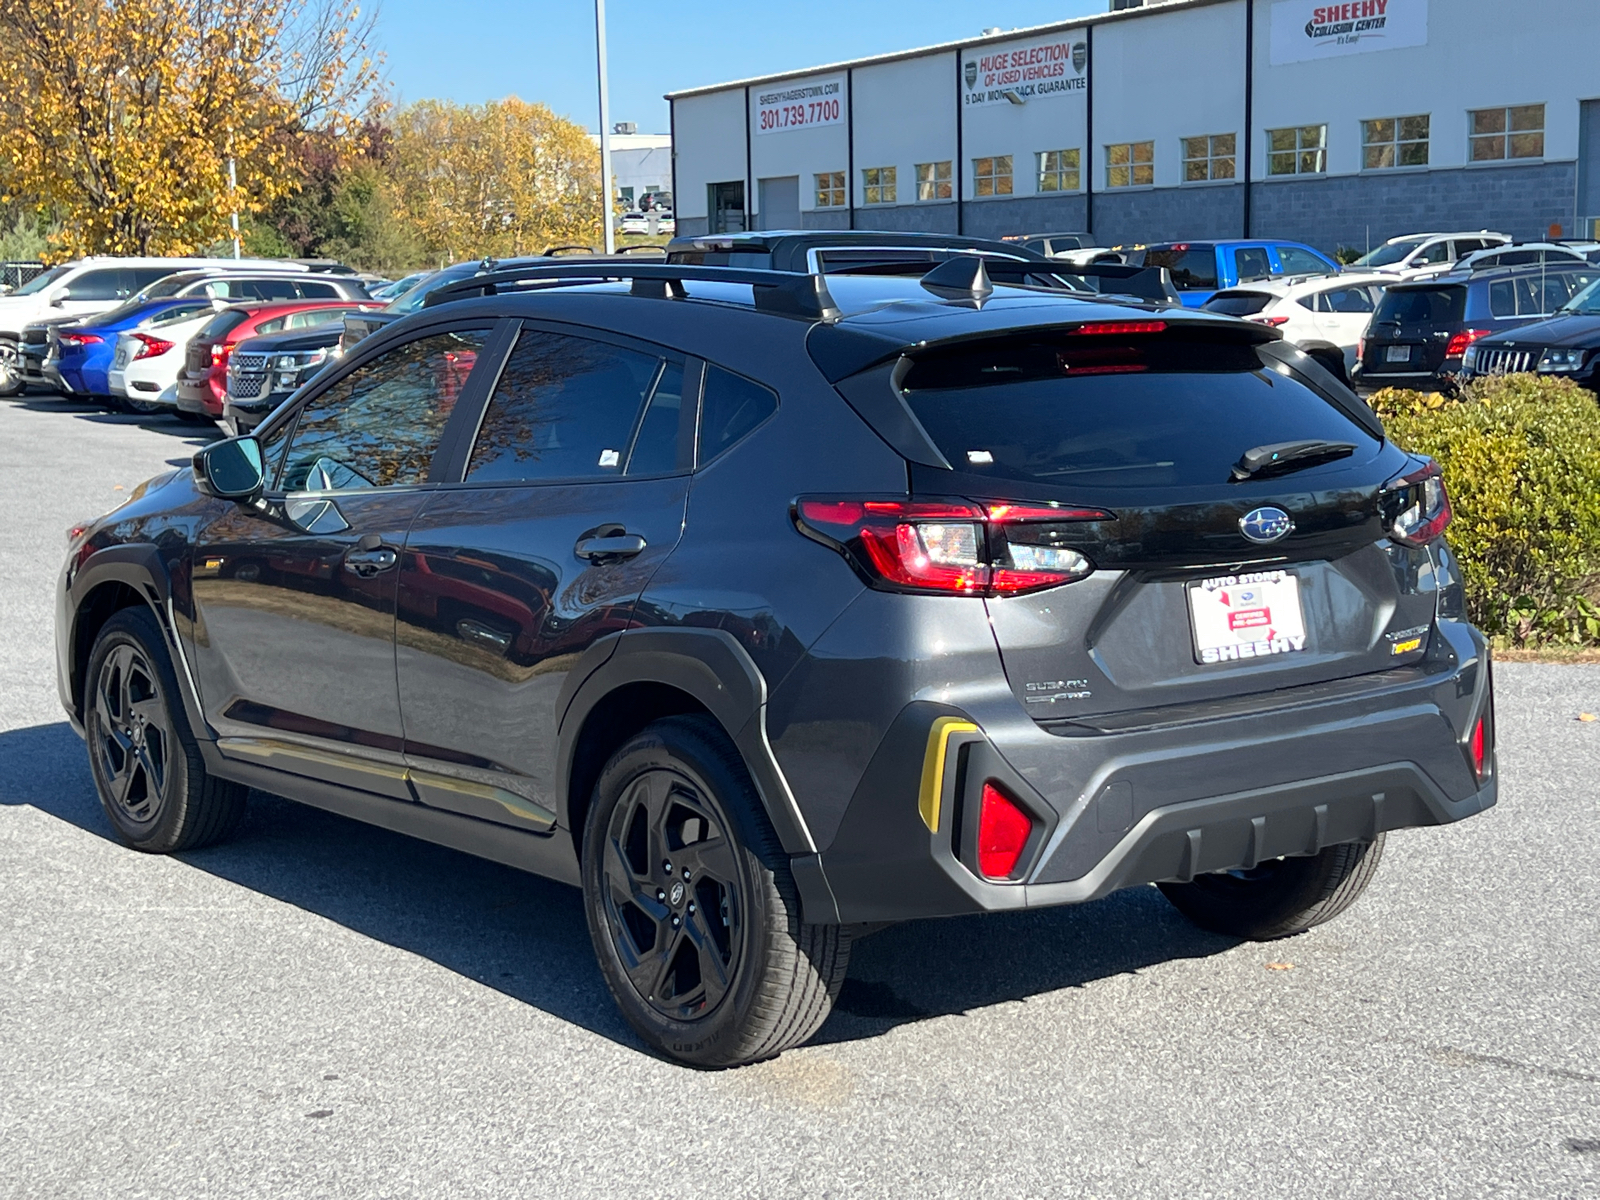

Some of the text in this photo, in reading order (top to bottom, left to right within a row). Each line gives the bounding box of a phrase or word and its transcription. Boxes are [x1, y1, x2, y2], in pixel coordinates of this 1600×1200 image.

[1313, 0, 1388, 25] SHEEHY
[1313, 17, 1386, 38] COLLISION CENTER
[980, 53, 1009, 73] HUGE
[1011, 43, 1070, 68] SELECTION
[984, 72, 996, 87] OF
[997, 69, 1021, 85] USED
[1022, 62, 1065, 82] VEHICLES
[759, 83, 840, 106] SHEEHYHAGERSTOWN.COM
[965, 94, 970, 105] 5
[971, 93, 986, 104] DAY
[1037, 77, 1086, 95] GUARANTEE
[760, 99, 840, 130] 301.739.7700
[1202, 576, 1237, 589] AUTO
[1201, 635, 1306, 663] SHEEHY
